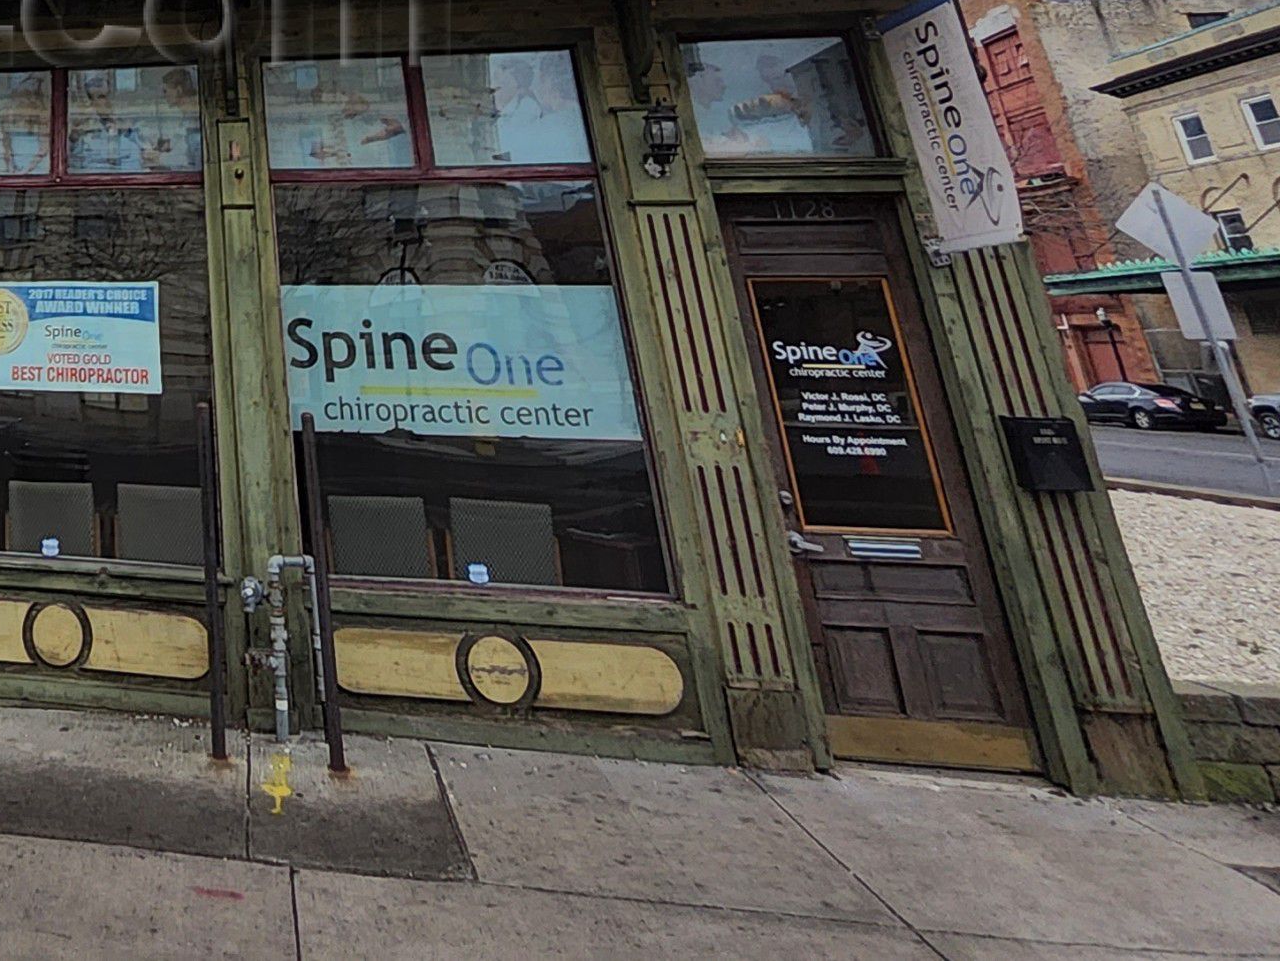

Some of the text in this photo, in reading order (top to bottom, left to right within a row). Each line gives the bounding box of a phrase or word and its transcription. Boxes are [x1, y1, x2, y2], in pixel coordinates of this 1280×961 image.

[914, 20, 962, 129] Spine
[903, 50, 960, 212] chiropractic center
[28, 289, 53, 300] 2017
[106, 290, 147, 301] CHOICE
[35, 301, 140, 314] AWARD WINNER
[44, 325, 81, 339] Spine
[286, 317, 565, 386] Spine One
[772, 340, 838, 364] Spine
[47, 353, 112, 365] VOTED GOLD
[11, 365, 149, 384] BEST CHIROPRACTOR
[789, 367, 886, 378] chiropractic center
[801, 391, 829, 401] Victor
[871, 393, 887, 402] DC
[323, 396, 595, 428] chiropractic center
[876, 404, 892, 413] DC
[885, 415, 901, 424] DC
[802, 434, 908, 446] Hours By Appointment
